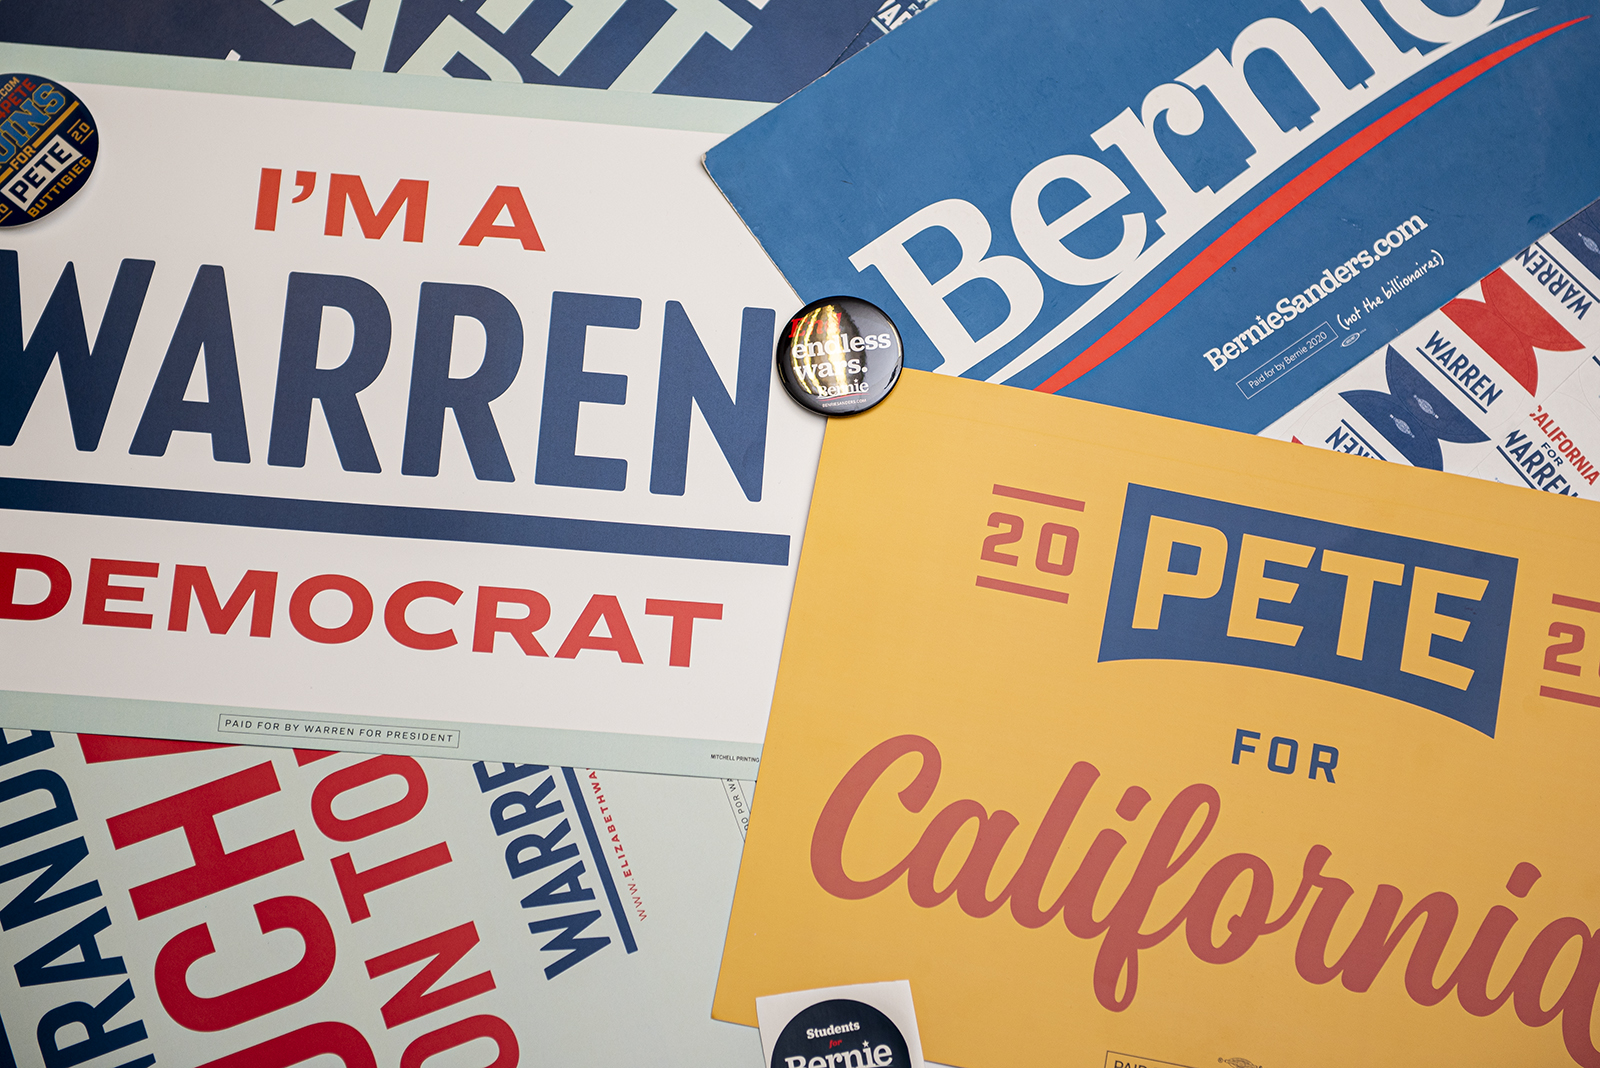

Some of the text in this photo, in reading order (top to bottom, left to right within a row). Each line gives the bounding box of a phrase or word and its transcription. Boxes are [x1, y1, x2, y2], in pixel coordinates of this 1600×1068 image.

[10, 145, 36, 170] FOR
[71, 122, 91, 142] 20
[8, 142, 73, 203] PETE
[27, 156, 92, 218] BUTTIGIEG
[458, 186, 546, 252] A
[1203, 214, 1429, 371] BernieSanders.com
[1337, 248, 1445, 331] (not the billionaires)
[1515, 245, 1593, 321] WARREN
[791, 333, 892, 359] endless
[793, 358, 868, 380] wars.
[1248, 373, 1266, 389] Paid
[1265, 363, 1278, 378] for
[1274, 356, 1286, 372] by
[1283, 343, 1310, 366] Bernie
[1306, 331, 1328, 350] 2020
[1424, 329, 1504, 407] WARREN
[0, 250, 776, 503] WARREN
[816, 379, 870, 399] Bernie
[1540, 441, 1564, 467] FOR
[980, 512, 1080, 577] 20
[0, 551, 724, 668] DEMOCRAT
[1131, 515, 1490, 691] PETE
[1543, 621, 1600, 678] 2
[225, 719, 454, 743] PAID FOR BY WARREN FOR PRESIDENT
[710, 753, 760, 764] MITCHELL PRINTING
[1231, 728, 1340, 784] FOR
[732, 794, 745, 815] POR
[585, 768, 648, 922] WWW.ELIZABETHWA
[810, 734, 1600, 1068] California
[806, 1021, 861, 1040] Students
[829, 1039, 843, 1049] for
